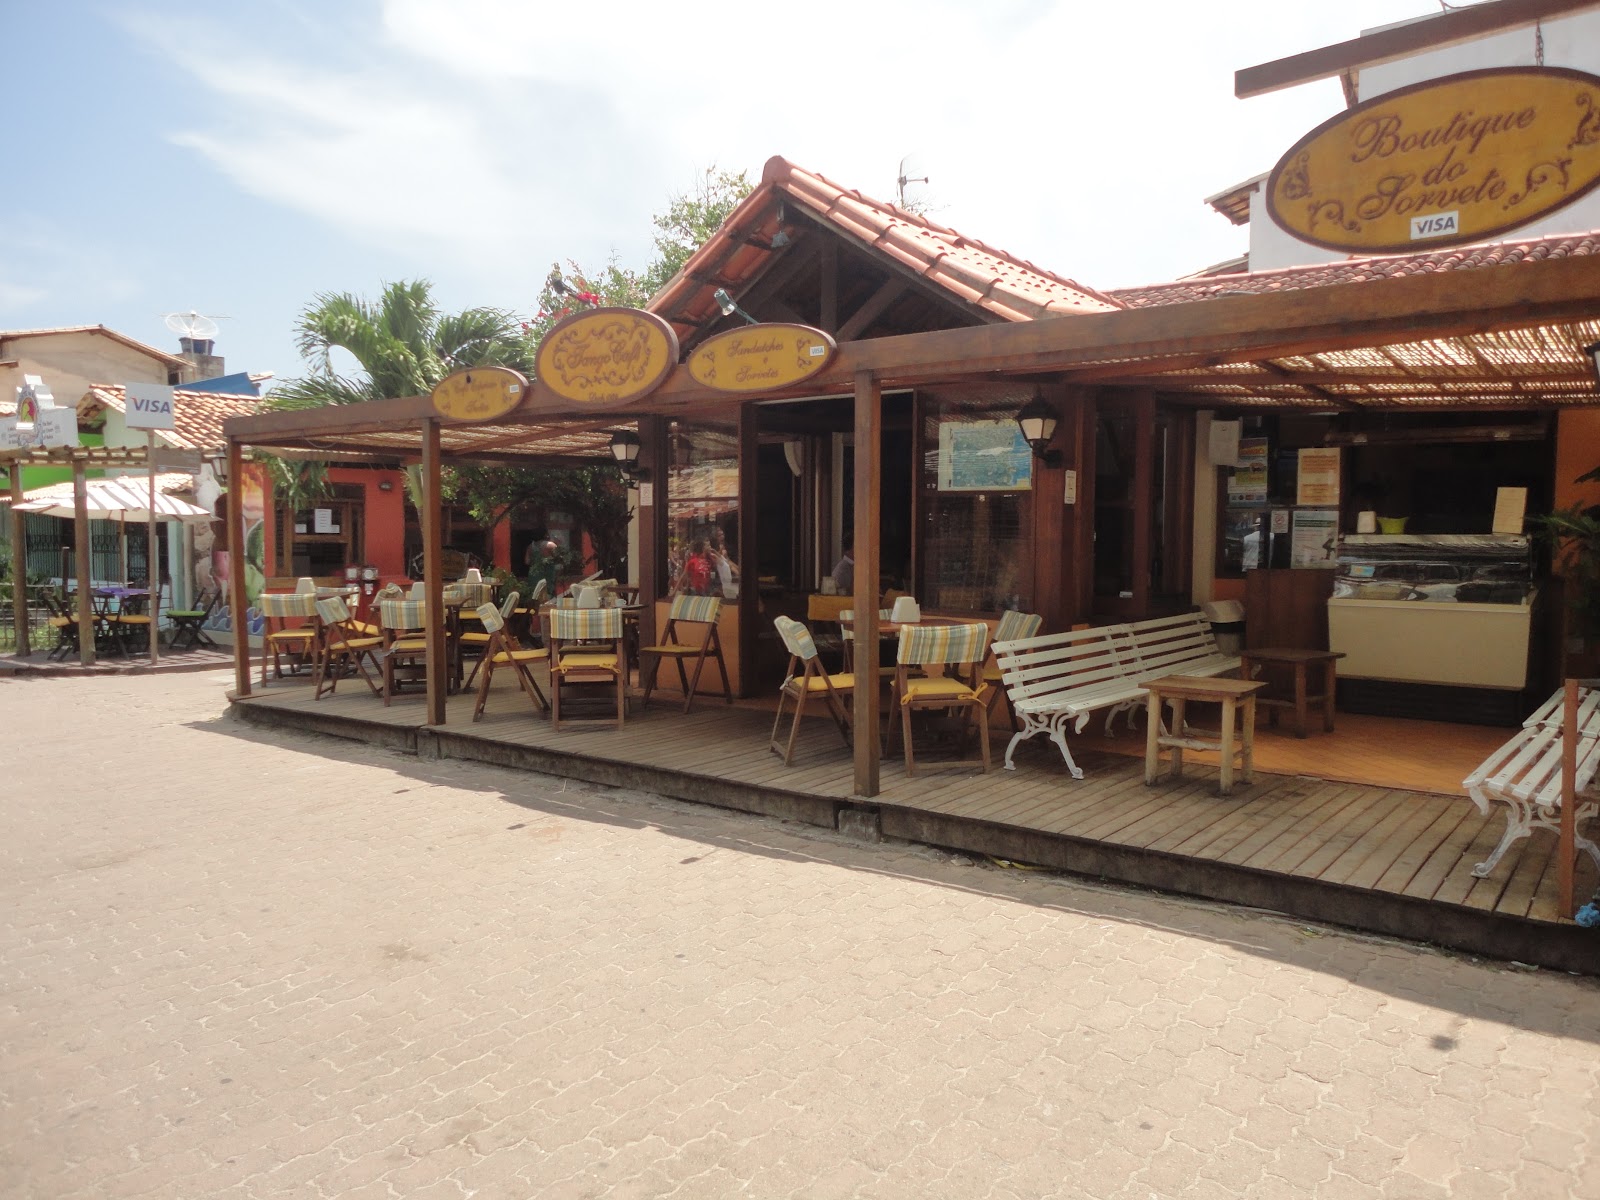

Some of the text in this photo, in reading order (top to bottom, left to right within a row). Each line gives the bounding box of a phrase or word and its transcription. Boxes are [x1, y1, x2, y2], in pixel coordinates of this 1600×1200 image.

[1351, 106, 1537, 163] Boutique
[1356, 168, 1507, 221] Sorvete
[1417, 216, 1455, 234] VISA
[131, 397, 171, 414] VISA
